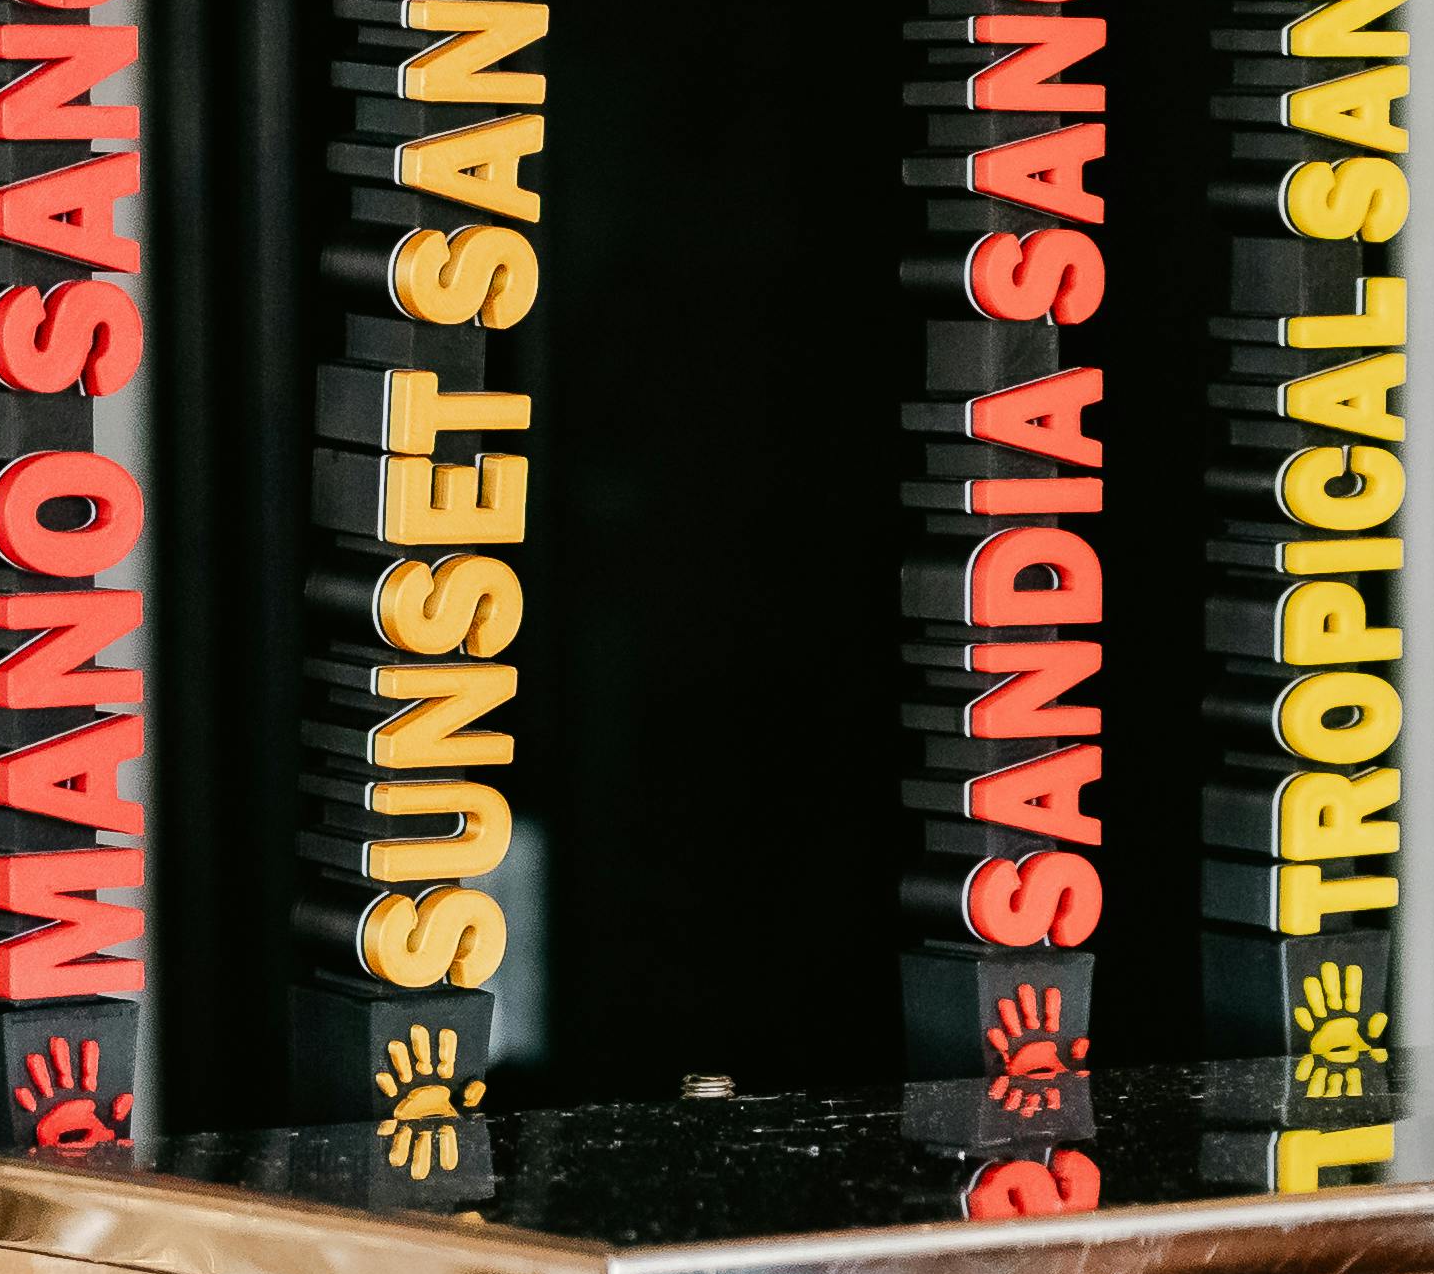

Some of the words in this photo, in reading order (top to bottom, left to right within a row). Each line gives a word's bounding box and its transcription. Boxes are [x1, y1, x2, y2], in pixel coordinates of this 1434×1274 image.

[356, 368, 532, 989] SUNSET
[963, 366, 1103, 949] SANDIA
[1270, 276, 1409, 936] TROPICAL
